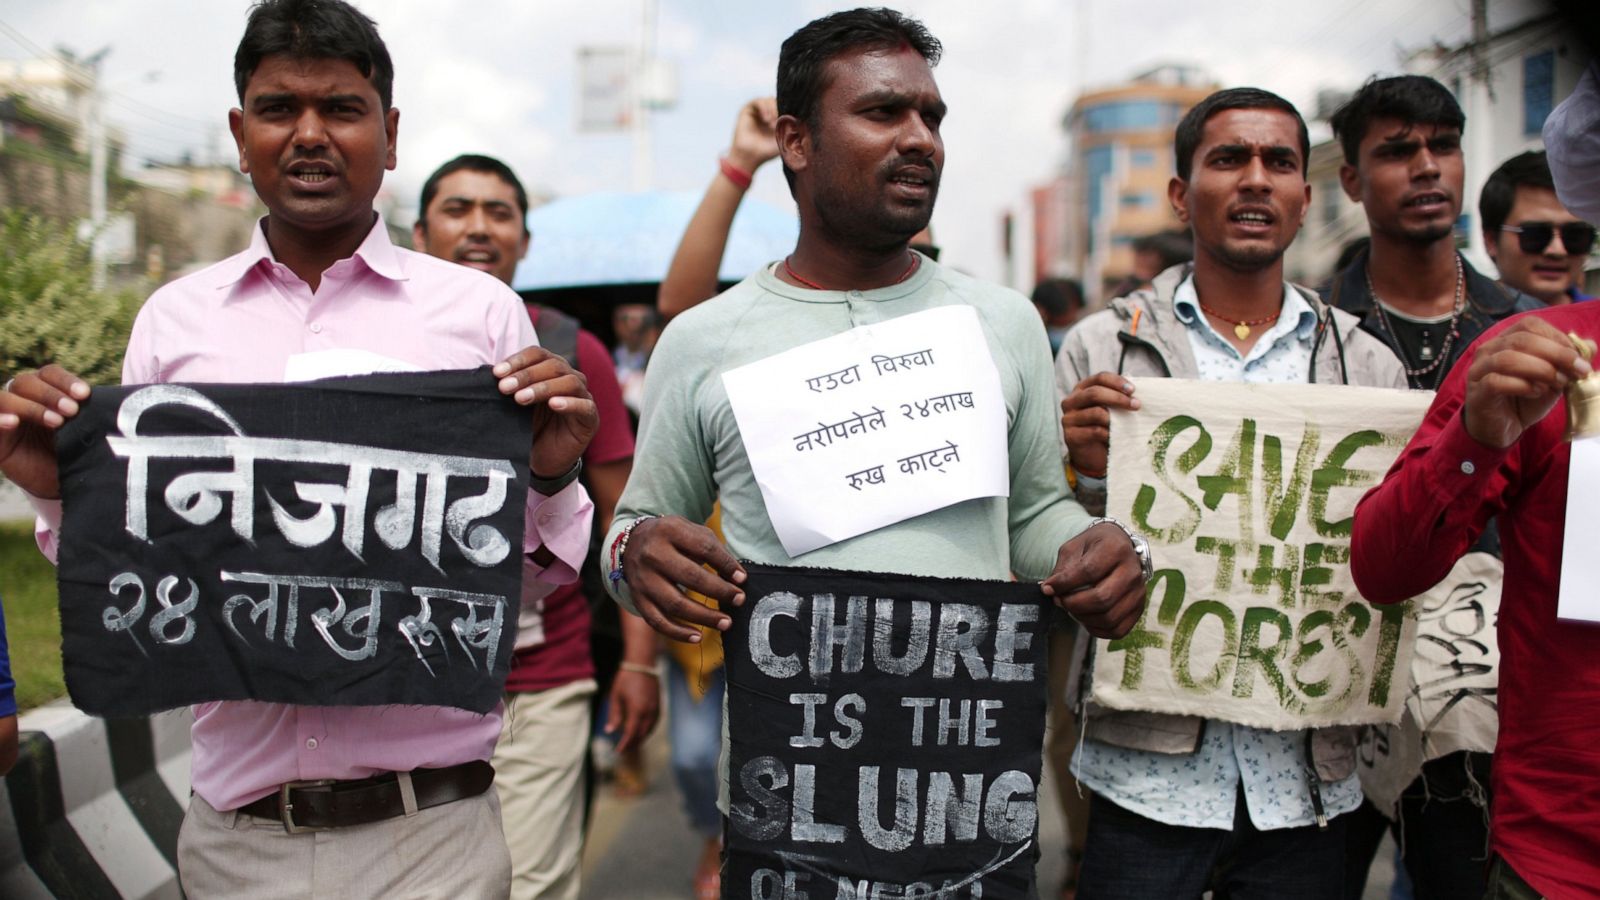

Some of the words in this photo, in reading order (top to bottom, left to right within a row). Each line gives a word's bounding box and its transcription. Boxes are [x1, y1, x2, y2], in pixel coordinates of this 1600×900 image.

[805, 364, 862, 393] एउटा
[871, 348, 935, 377] विरुवा
[793, 406, 887, 453] नरोपनेले
[845, 465, 886, 491] रुख
[897, 440, 961, 476] काट्ने
[1131, 414, 1412, 553] SAVE
[1195, 535, 1352, 609] THE
[102, 571, 200, 658] २४
[220, 570, 402, 662] लाख
[748, 591, 1039, 685] CHURE
[1107, 569, 1420, 714] FOREST
[789, 692, 867, 749] IS
[900, 697, 1004, 747] THE
